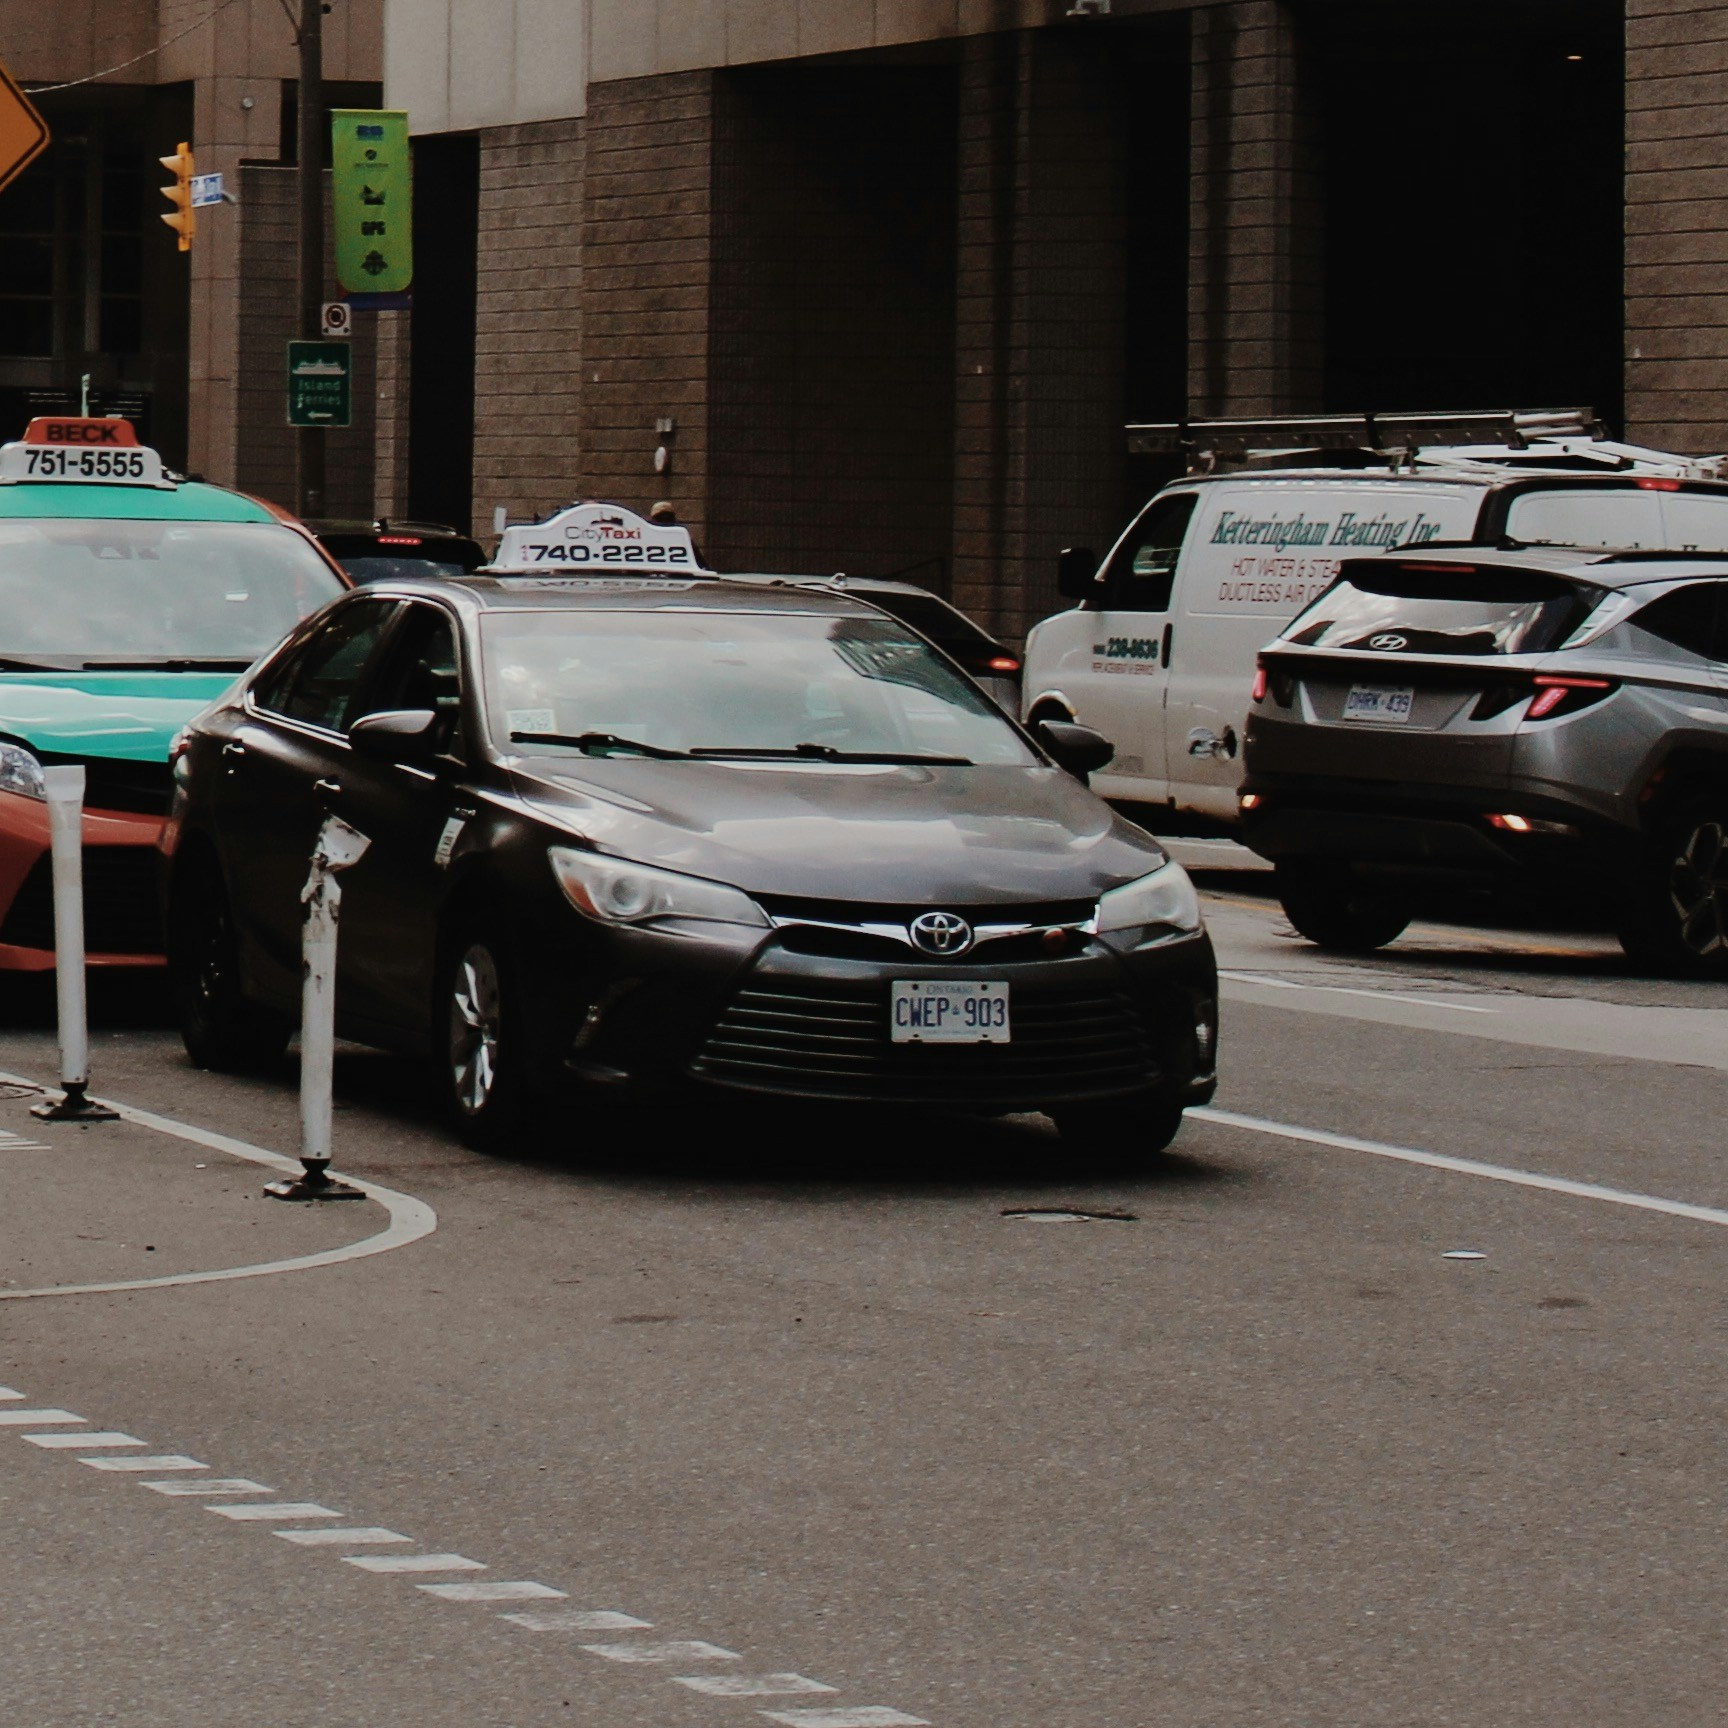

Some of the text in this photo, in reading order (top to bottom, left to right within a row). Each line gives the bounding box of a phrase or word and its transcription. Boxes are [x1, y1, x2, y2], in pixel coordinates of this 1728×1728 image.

[298, 379, 341, 391] Island
[298, 394, 341, 406] Ferries
[46, 424, 119, 443] BECK
[25, 449, 144, 478] 751-5555
[1210, 511, 1330, 553] Ketteringham
[1328, 512, 1409, 554] Heating
[1232, 558, 1256, 576] HOT
[1258, 558, 1294, 578] WATER
[1308, 559, 1342, 579] STEA
[1218, 583, 1281, 603] DUCTLESS
[1283, 583, 1305, 603] AIR
[895, 997, 1005, 1027] CWEP 903
